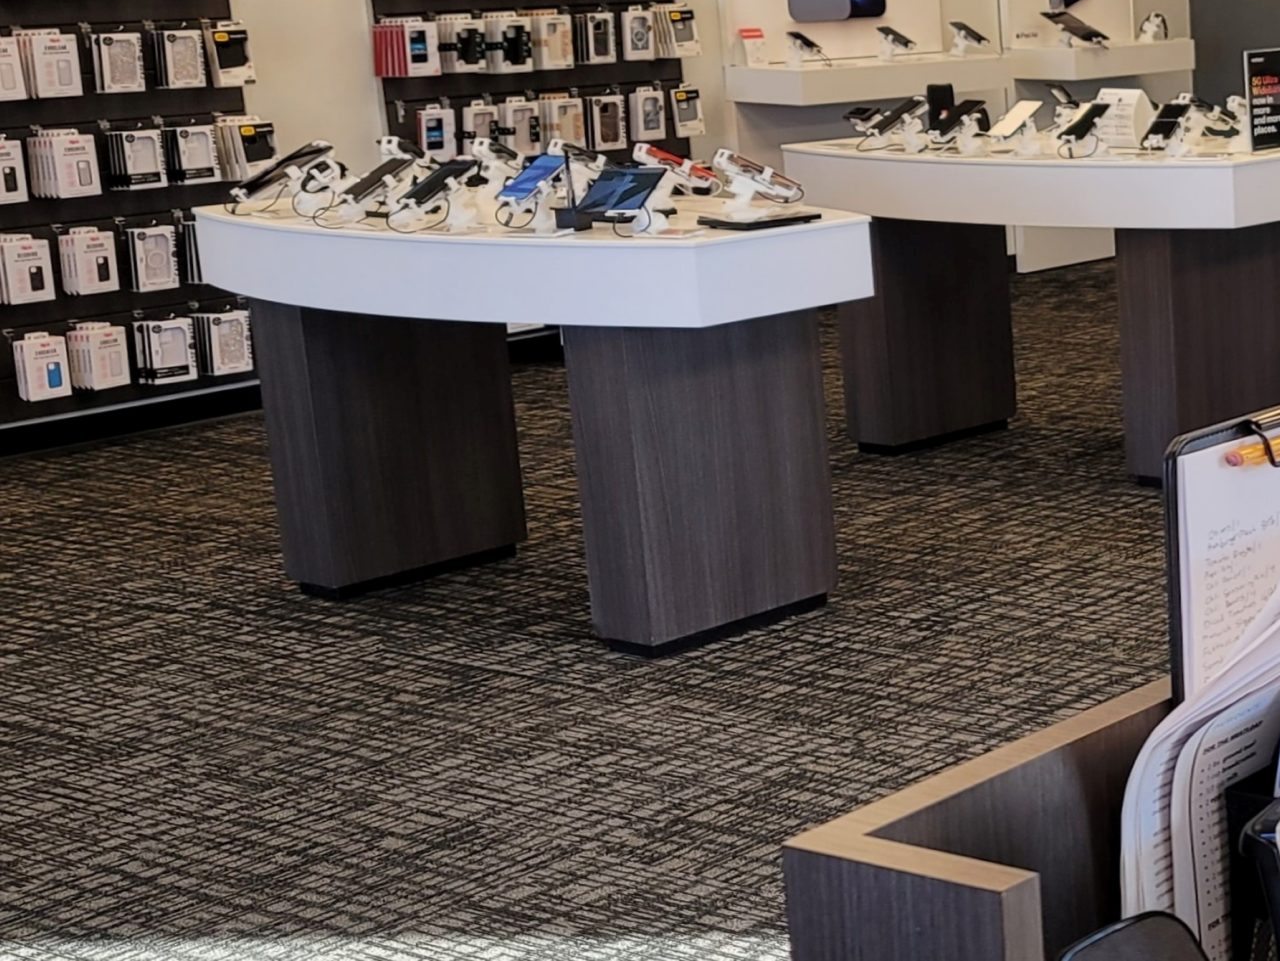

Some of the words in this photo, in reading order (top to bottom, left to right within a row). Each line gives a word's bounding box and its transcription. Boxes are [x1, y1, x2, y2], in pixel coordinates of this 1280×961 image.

[1252, 106, 1271, 115] more
[1253, 115, 1266, 125] and
[1253, 125, 1278, 137] places.
